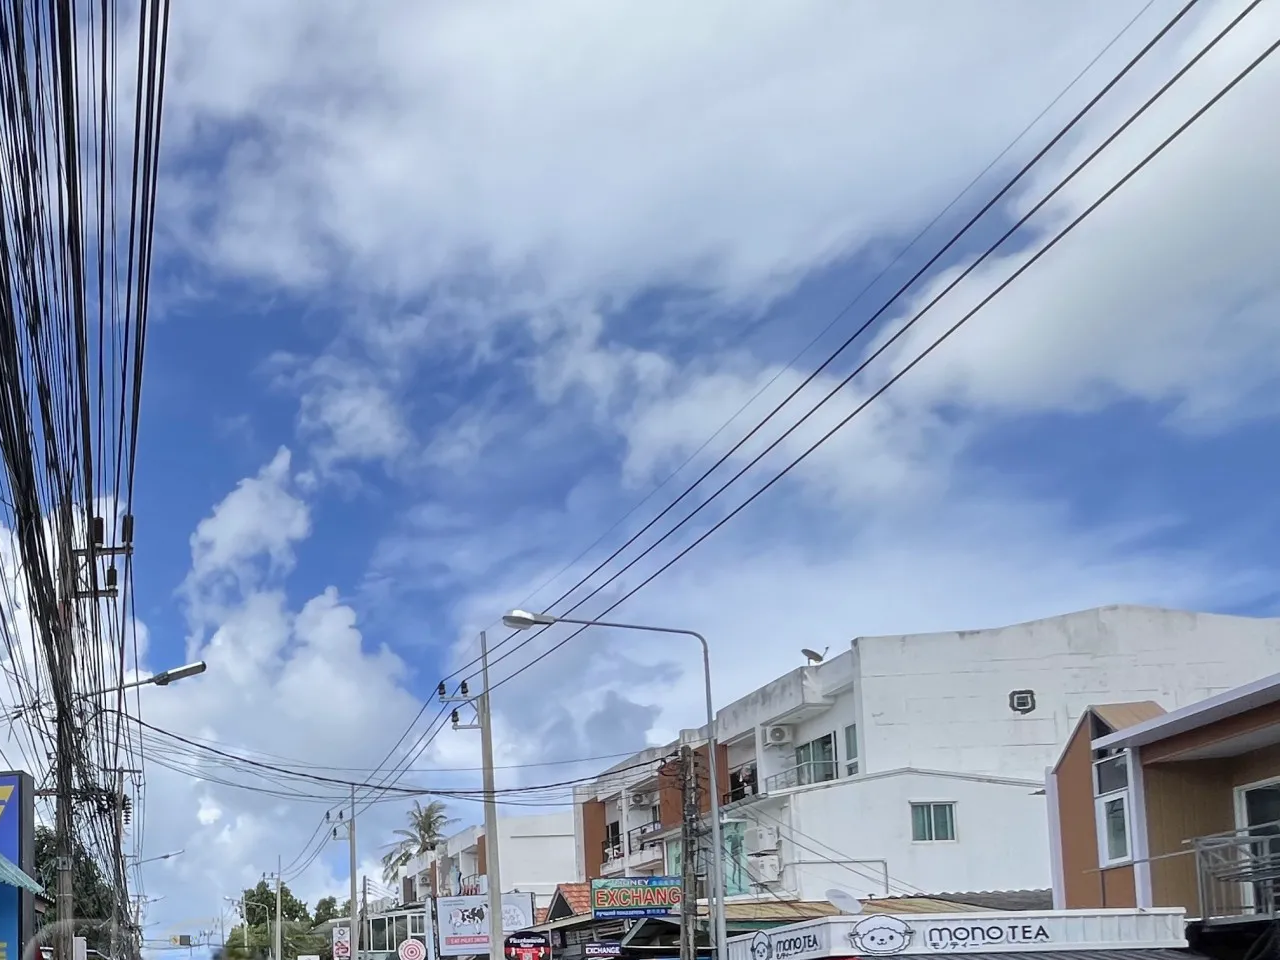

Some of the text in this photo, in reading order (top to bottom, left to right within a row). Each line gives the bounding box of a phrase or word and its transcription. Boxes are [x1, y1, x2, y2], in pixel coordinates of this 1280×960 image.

[595, 887, 682, 907] EXCHANG
[1008, 925, 1050, 939] TEA
[803, 934, 819, 948] TEA
[585, 946, 620, 954] EXCHANGE
